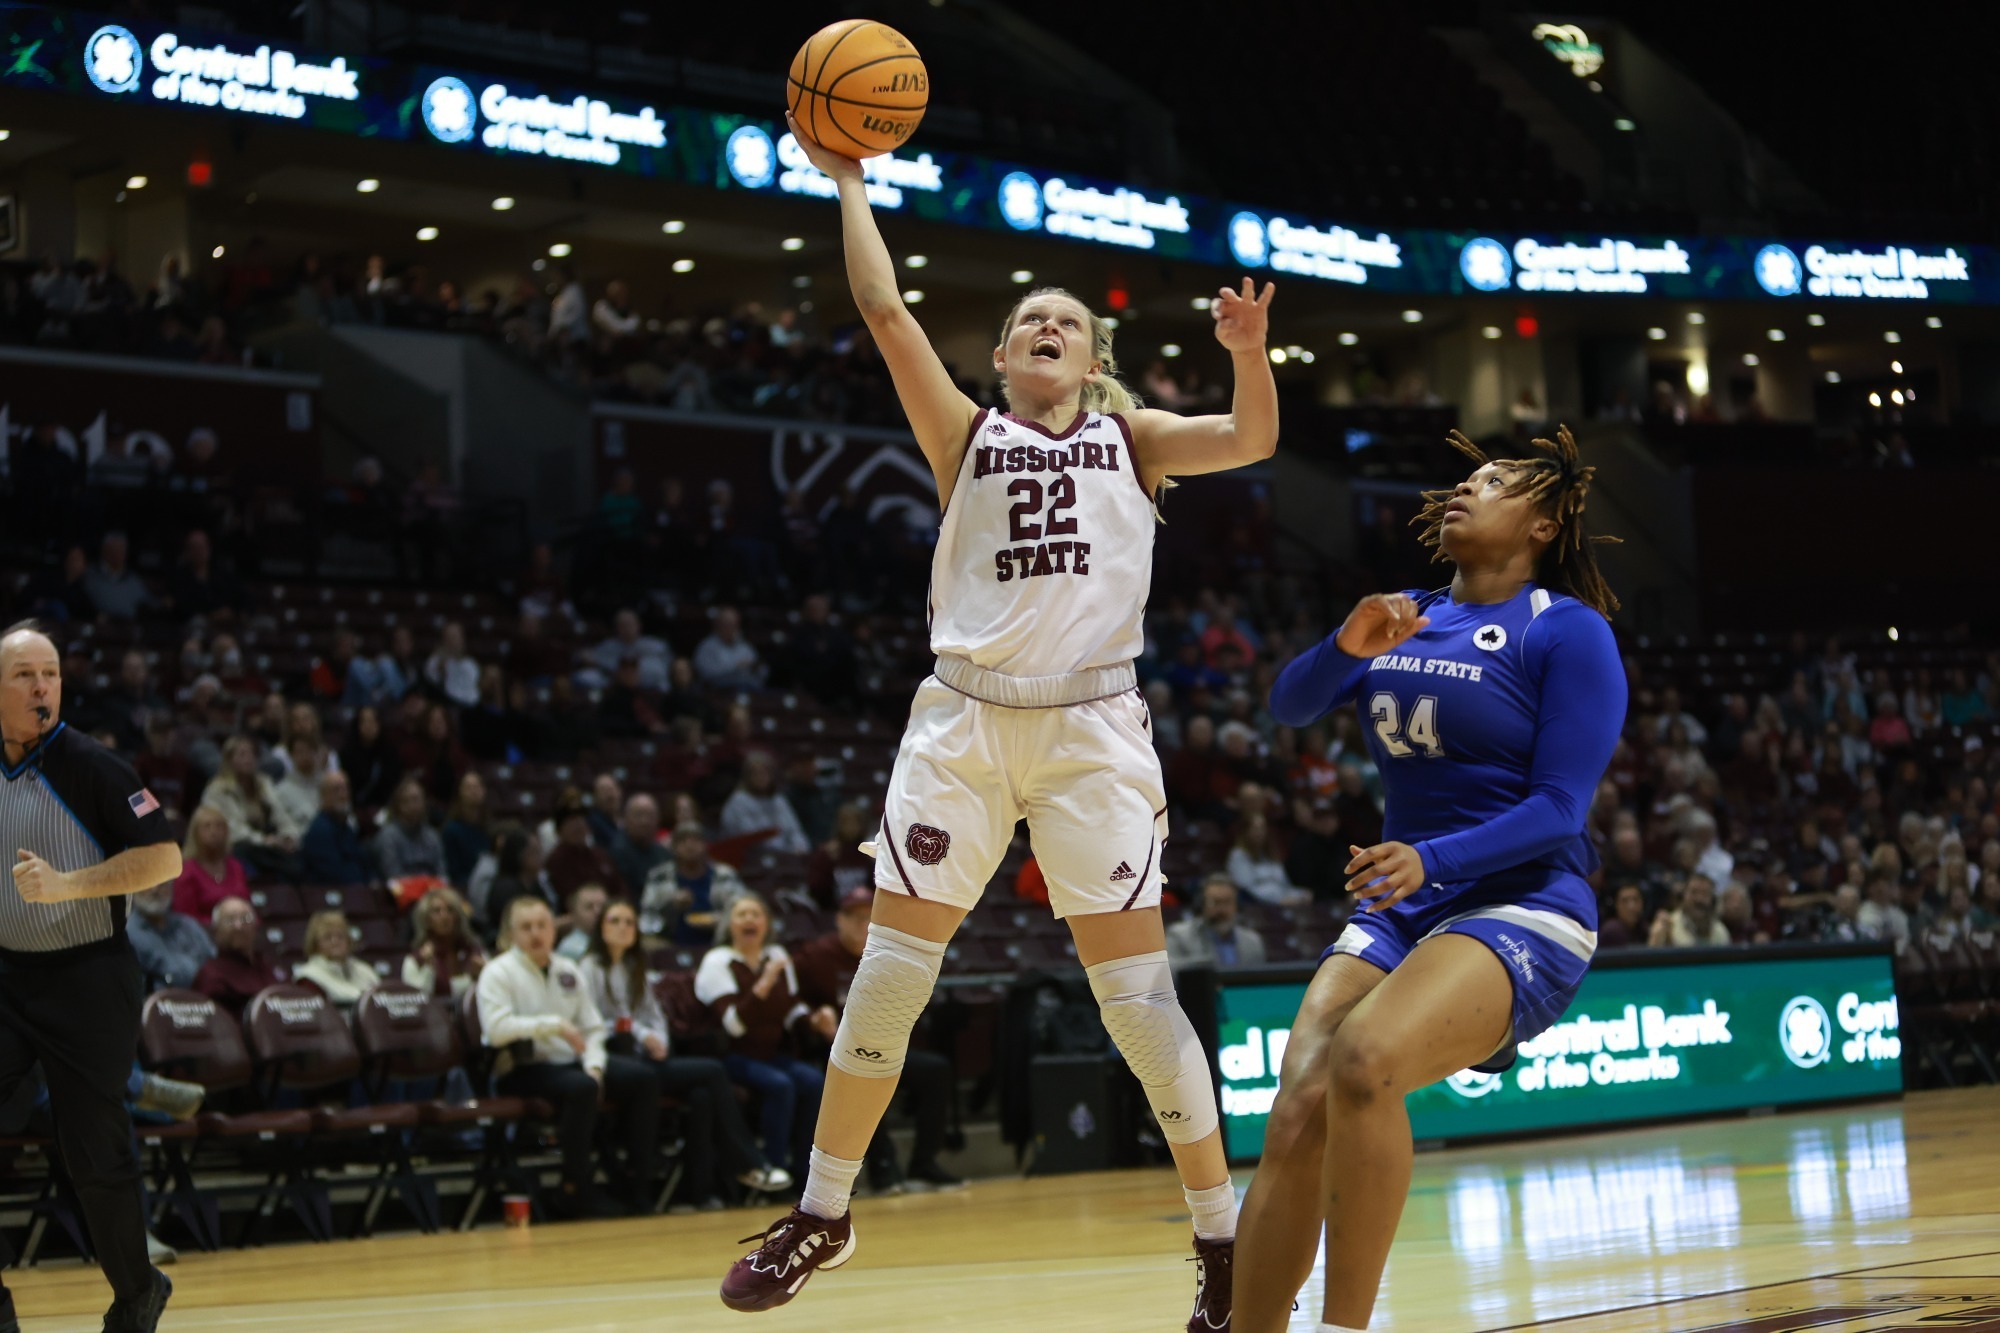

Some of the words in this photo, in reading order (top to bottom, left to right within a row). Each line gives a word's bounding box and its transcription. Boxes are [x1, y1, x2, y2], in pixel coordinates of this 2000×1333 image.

[1007, 473, 1077, 541] 22
[995, 541, 1091, 582] STATE
[1368, 655, 1421, 672] NDIANA
[1423, 659, 1483, 682] STATE
[1370, 691, 1444, 758] 24
[1110, 872, 1137, 881] adidas
[1640, 999, 1732, 1049] Bank
[1842, 1030, 1866, 1063] of
[1517, 1055, 1547, 1091] of
[1547, 1054, 1590, 1089] the
[1590, 1048, 1680, 1085] Ozarks
